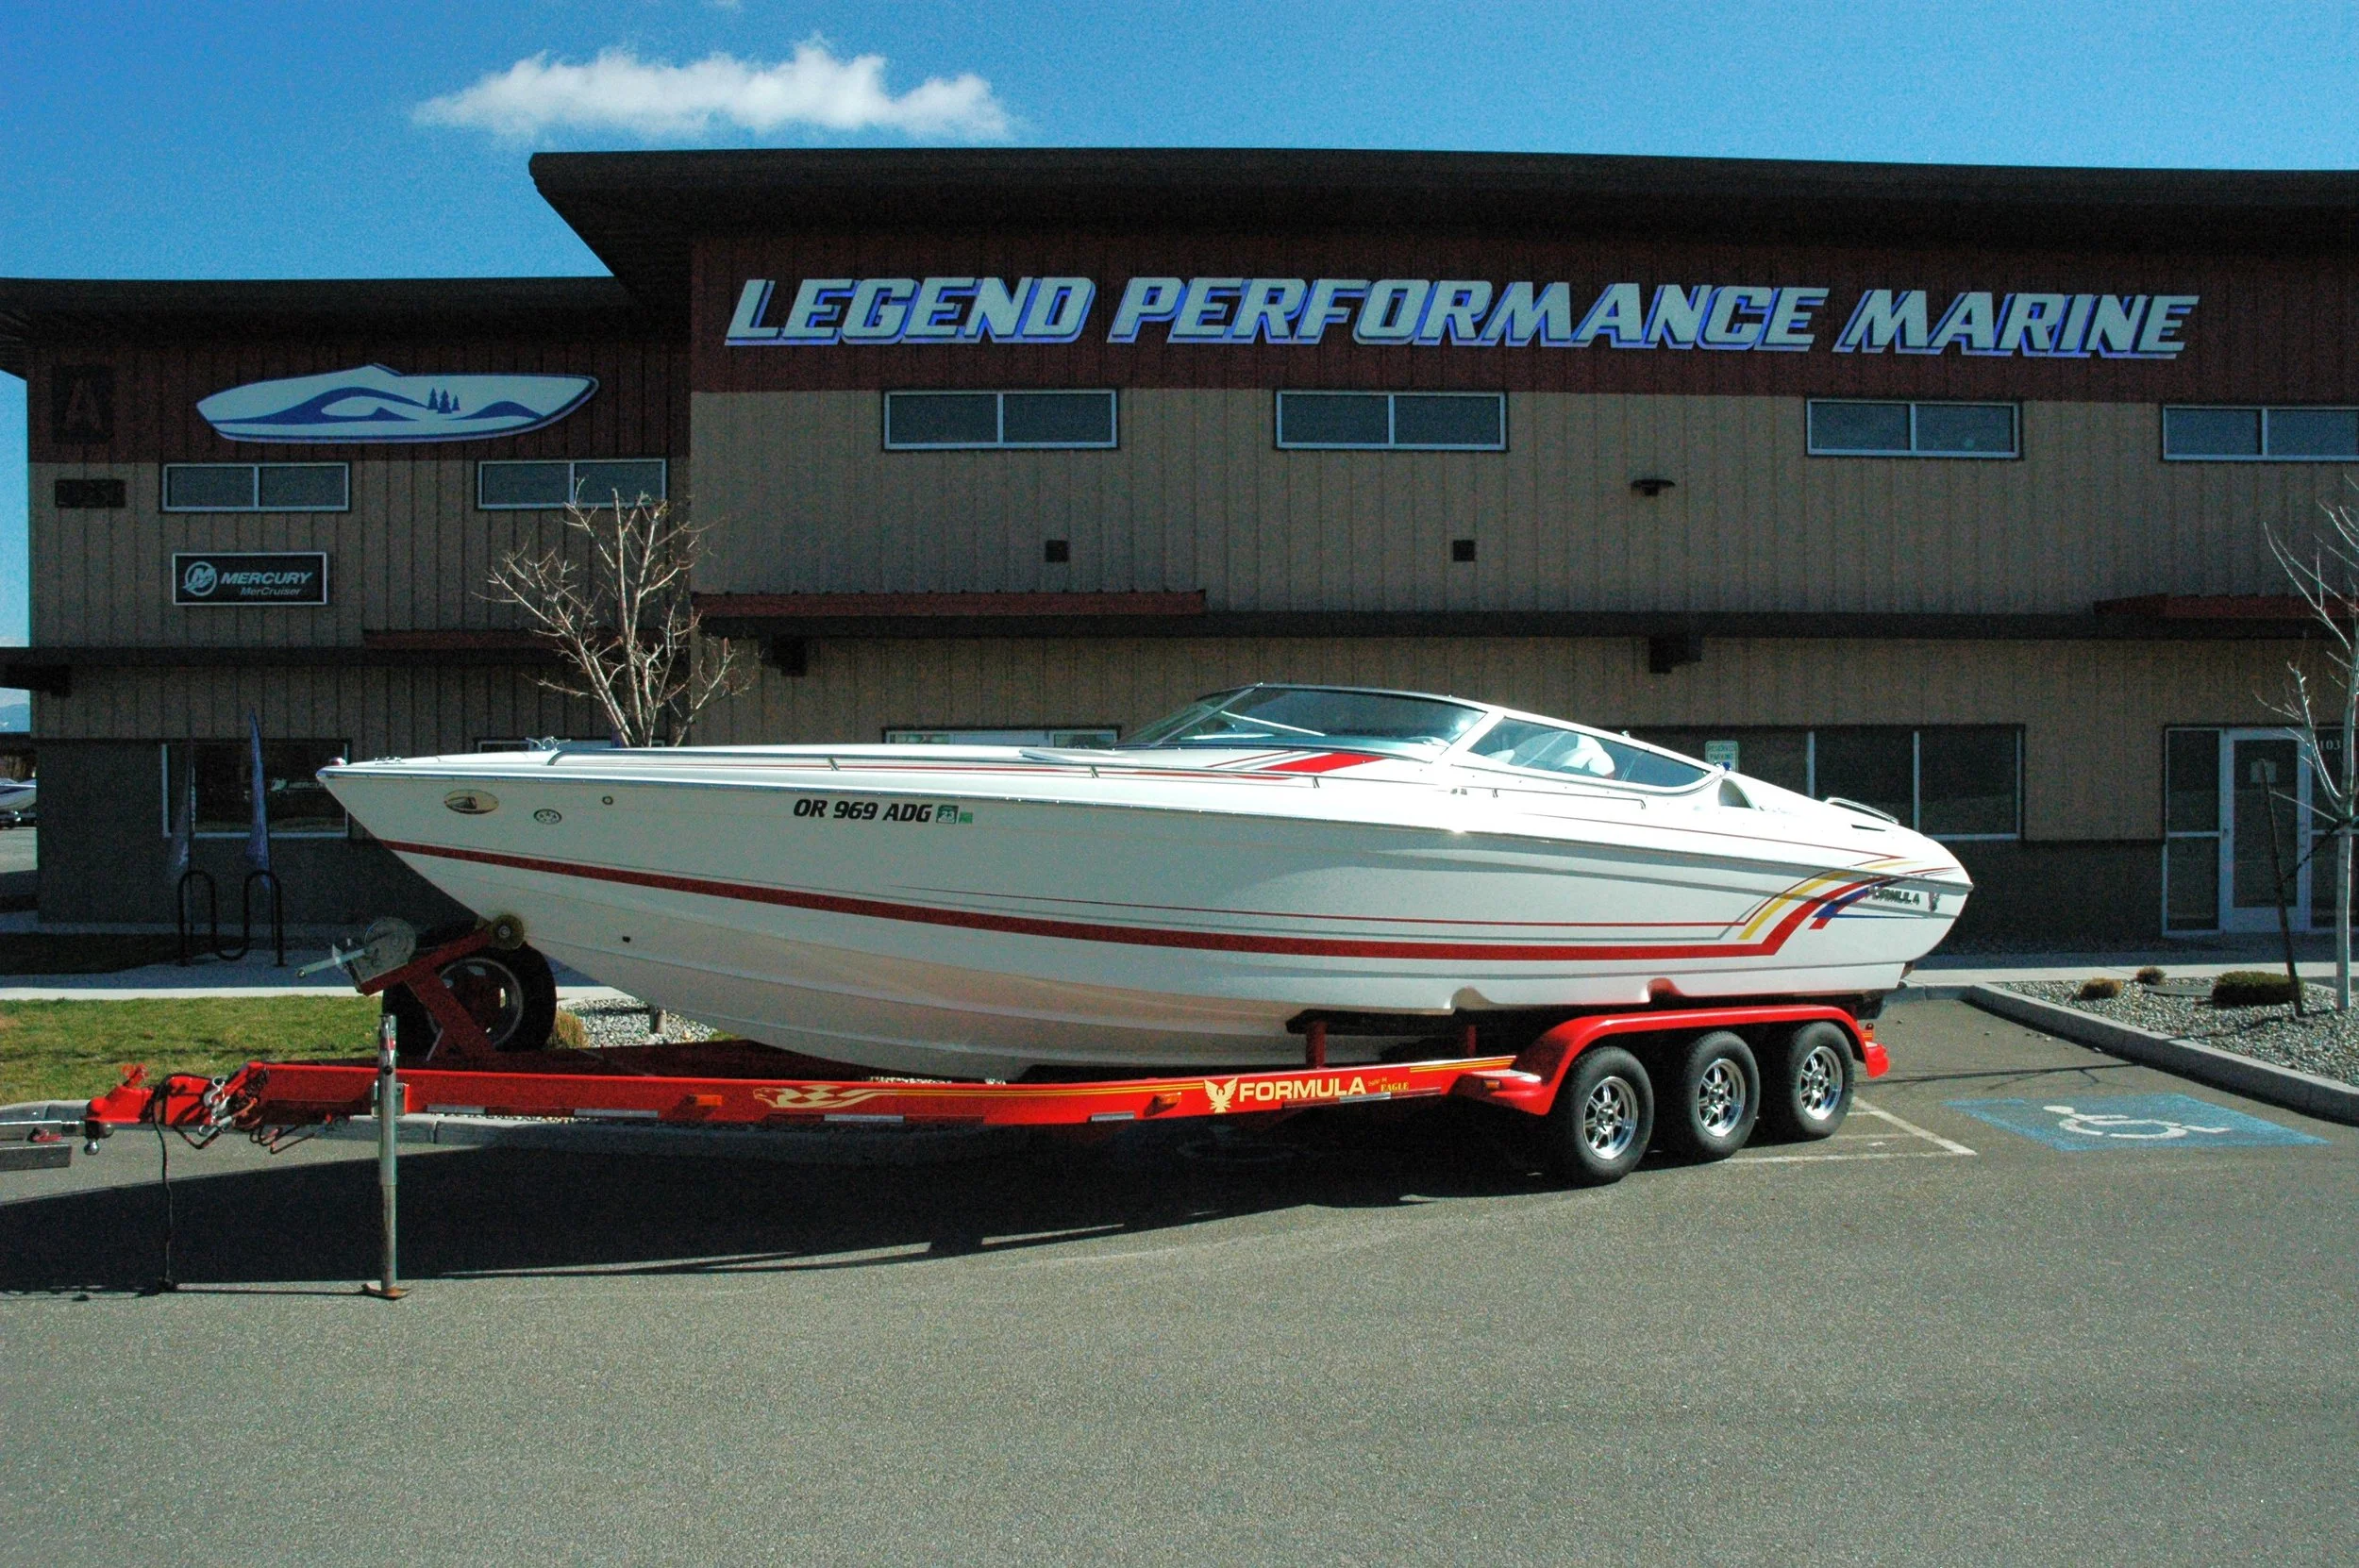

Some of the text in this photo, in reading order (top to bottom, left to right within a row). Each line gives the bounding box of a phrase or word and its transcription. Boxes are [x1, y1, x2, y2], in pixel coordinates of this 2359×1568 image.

[725, 276, 2200, 360] LEGEND PERFORMANCE MARINE
[221, 572, 312, 585] MERCURY
[241, 587, 302, 596] MerCruiser
[794, 798, 933, 823] OR 969 ADG
[1239, 1076, 1366, 1102] FORMULA
[1380, 1081, 1410, 1092] EAGLE
